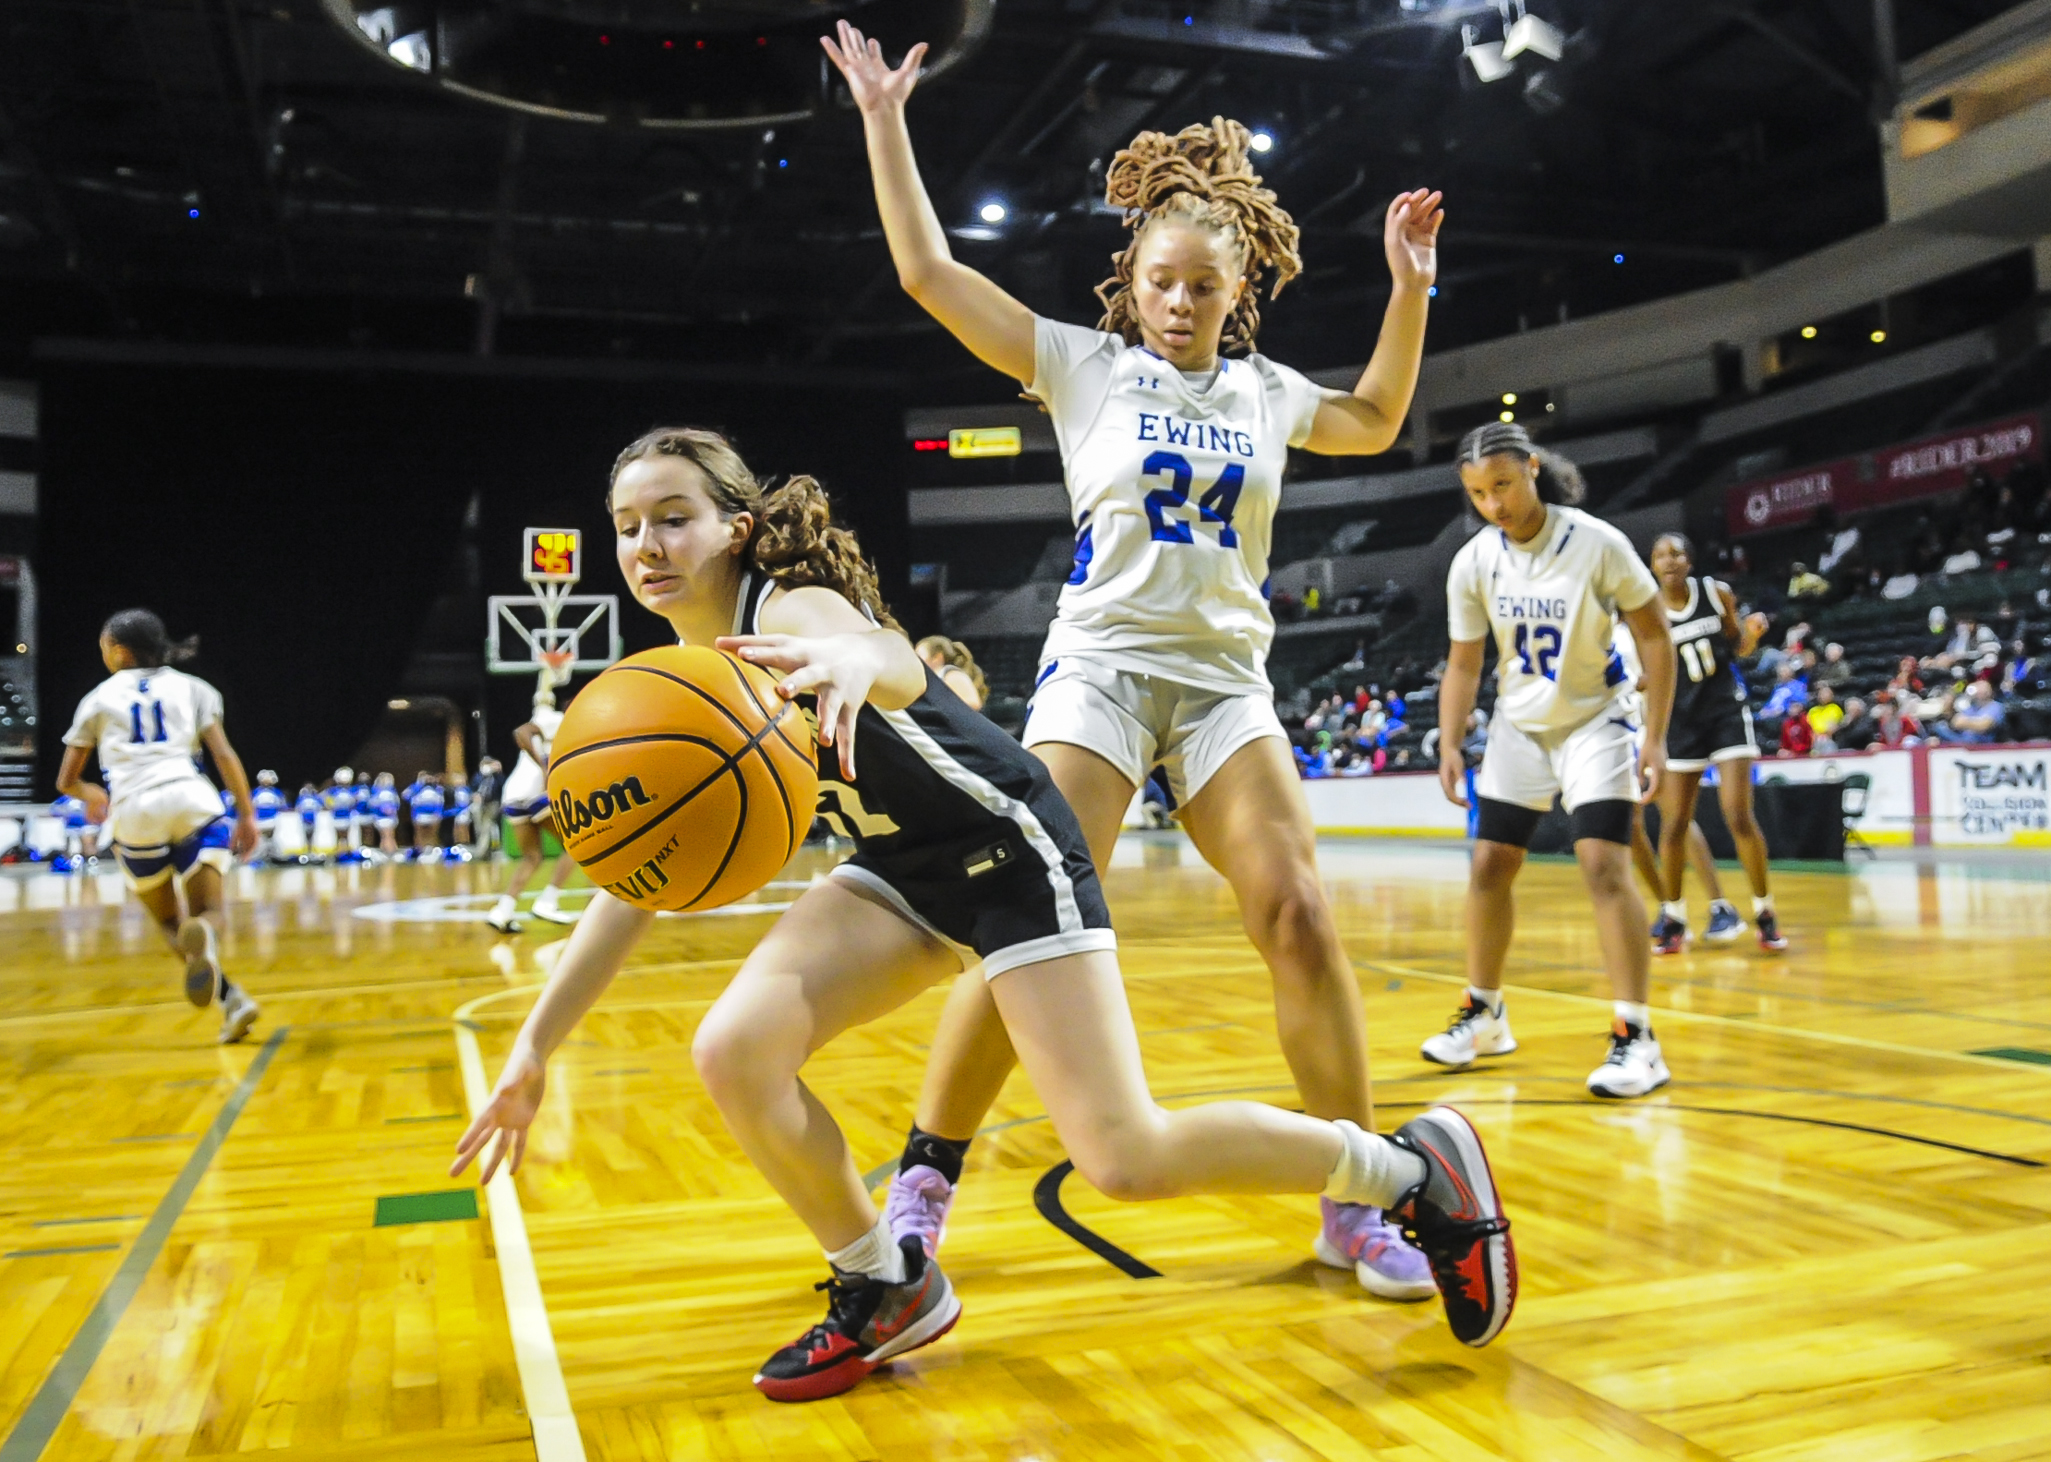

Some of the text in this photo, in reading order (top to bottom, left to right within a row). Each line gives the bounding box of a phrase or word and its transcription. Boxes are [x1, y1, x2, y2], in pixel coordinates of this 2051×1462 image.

[1137, 412, 1255, 458] EWING
[1142, 449, 1246, 550] 24
[1498, 596, 1567, 621] EWING
[1680, 638, 1716, 683] 11
[130, 699, 168, 744] 11
[1954, 759, 2047, 791] TEAM
[654, 833, 680, 864] NXT
